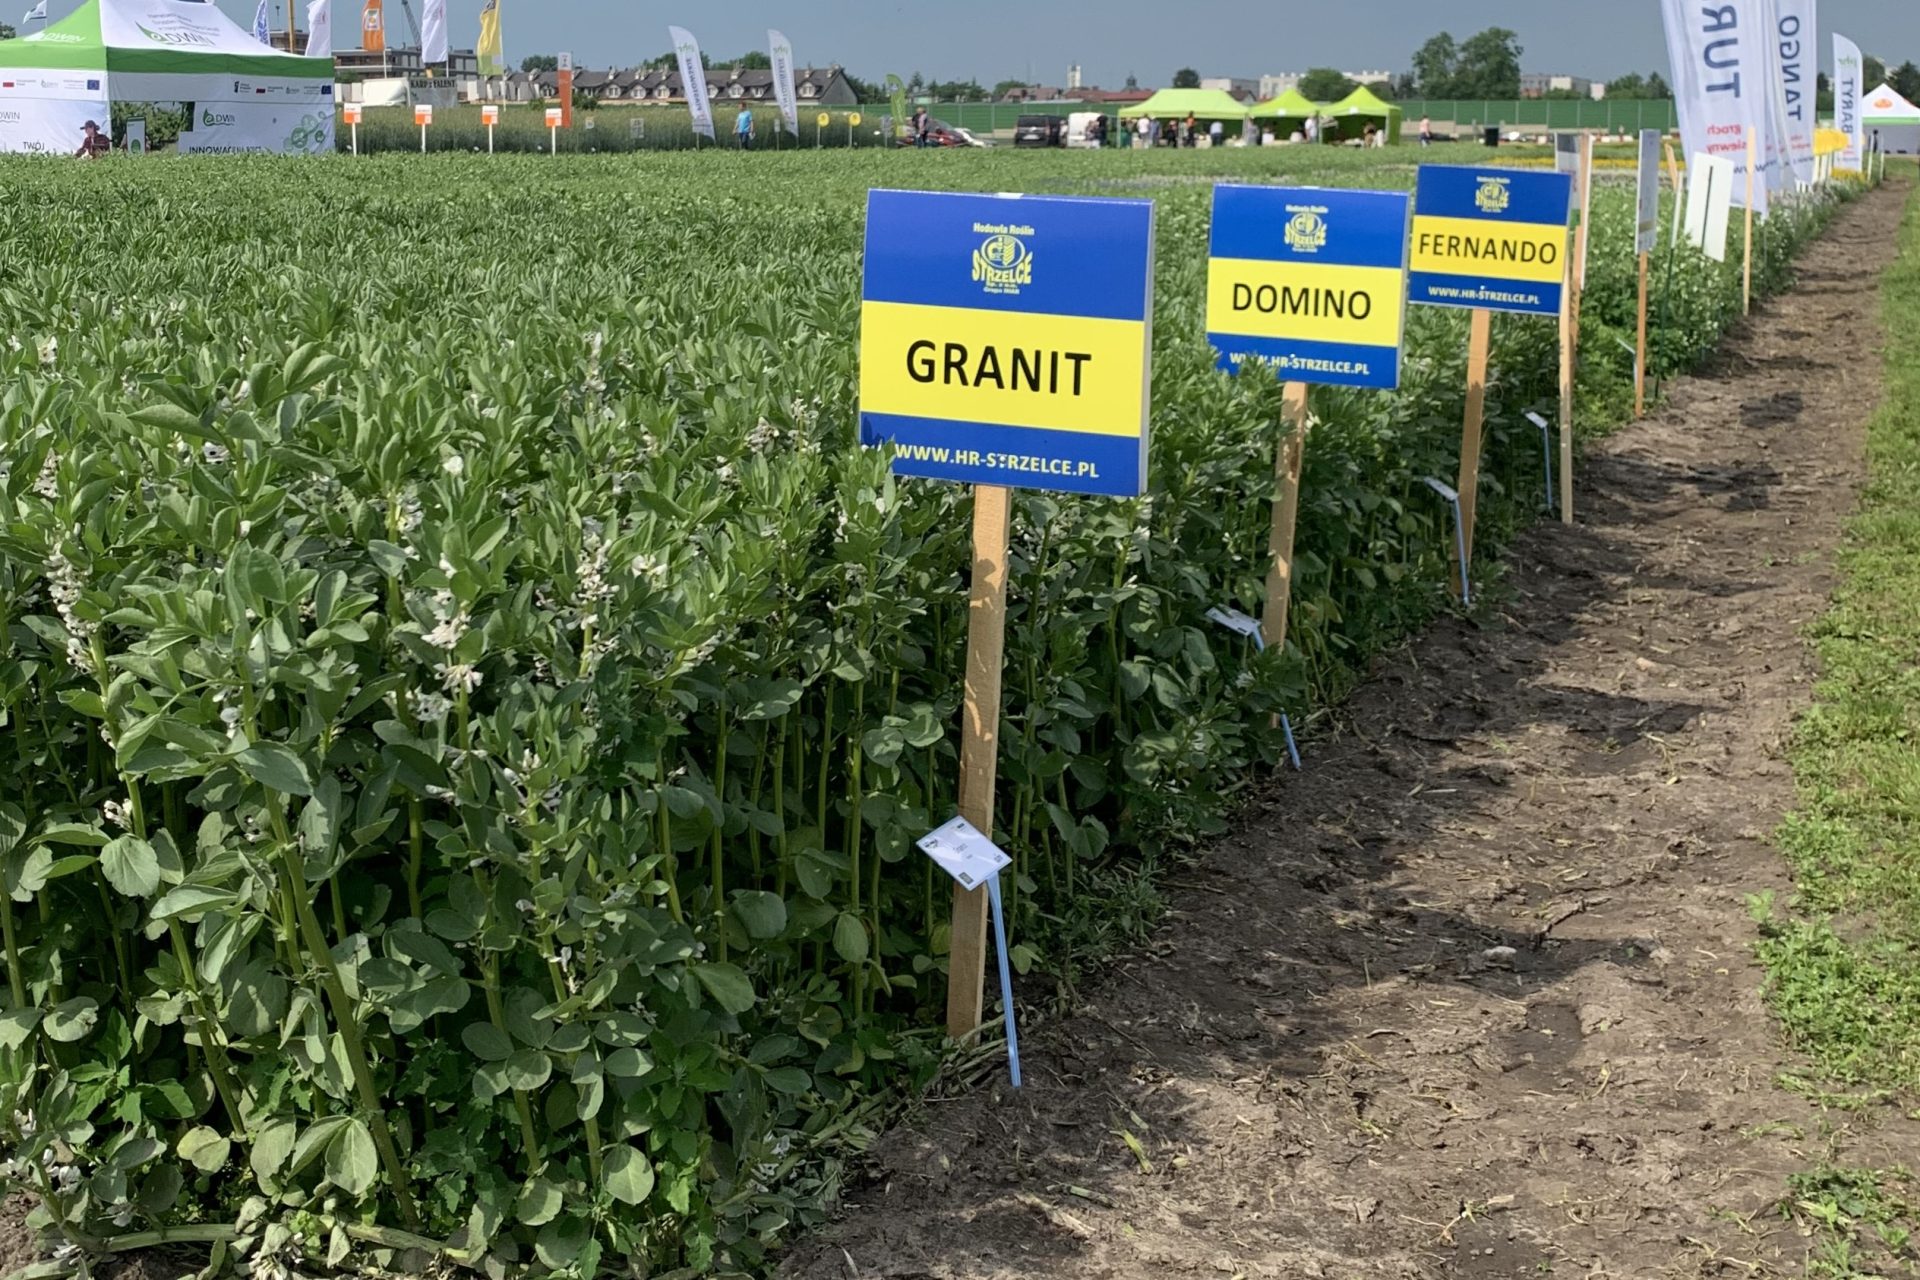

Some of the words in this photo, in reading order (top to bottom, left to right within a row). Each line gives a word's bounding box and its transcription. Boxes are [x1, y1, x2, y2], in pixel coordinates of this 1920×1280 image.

[1418, 233, 1557, 265] FERNANDO
[972, 249, 1033, 285] STRZELCE
[1232, 283, 1372, 320] DOMINO
[1428, 285, 1540, 305] WWW.HR-STRZELCE.PL
[906, 340, 1092, 396] GRANIT
[1229, 352, 1370, 375] WW.HR-STRZELCE.PL
[894, 443, 1100, 478] WWW.HR-STRZELCE.PL
